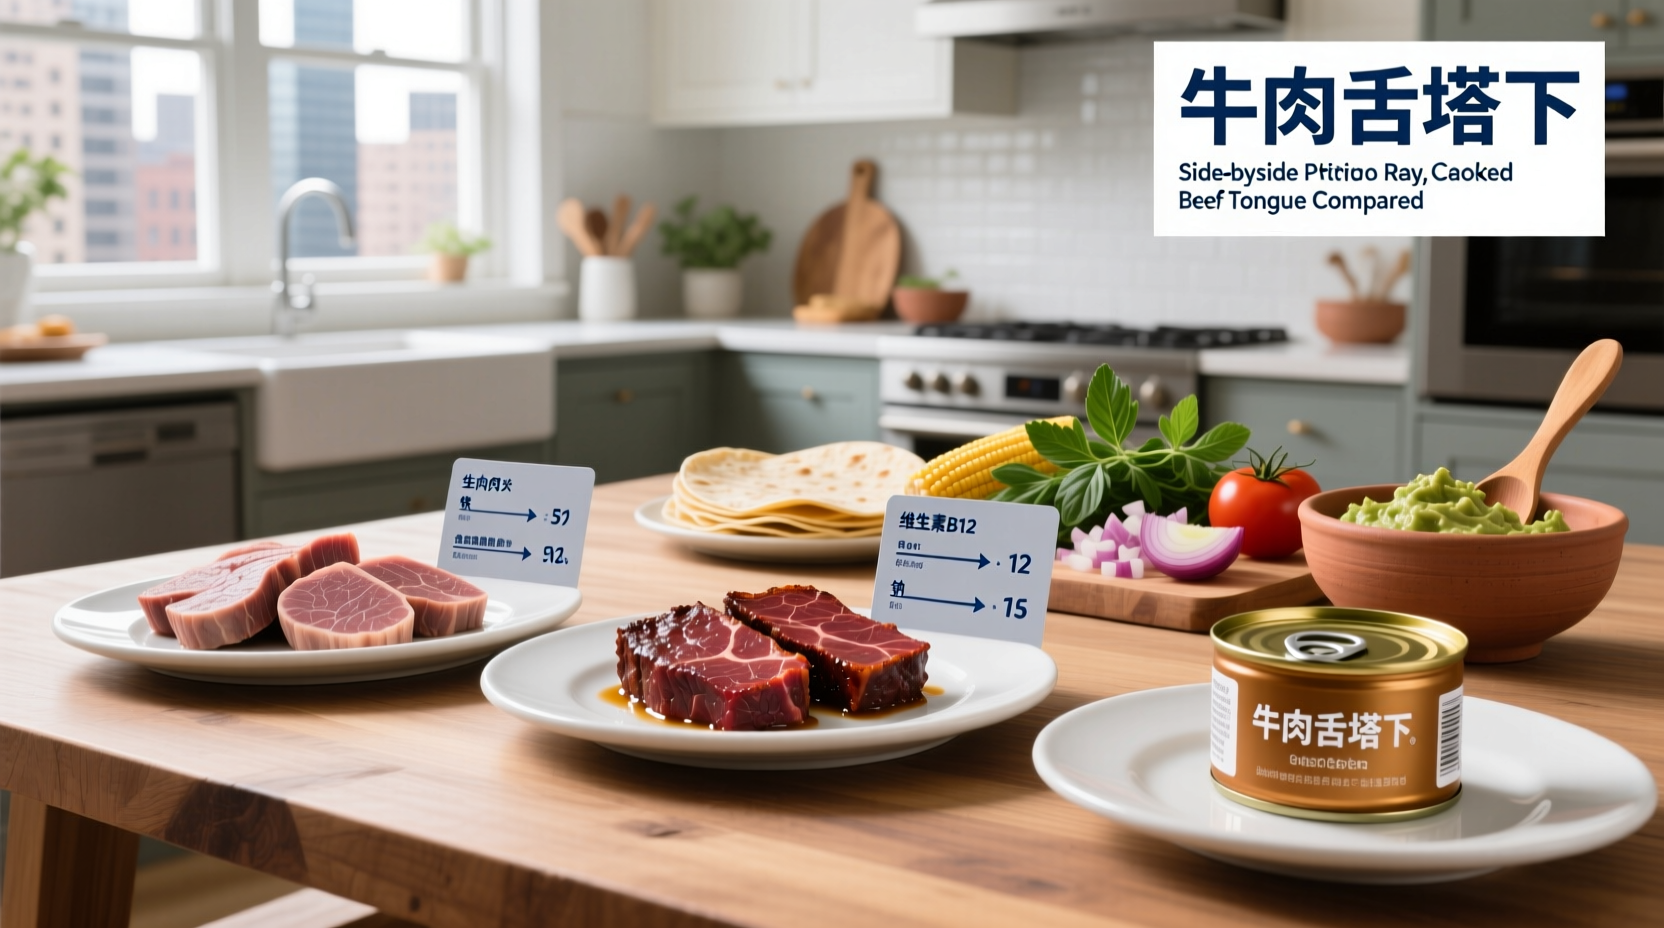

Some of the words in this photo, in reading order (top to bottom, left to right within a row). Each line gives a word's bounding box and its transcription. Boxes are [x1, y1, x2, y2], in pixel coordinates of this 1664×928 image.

[899, 511, 977, 534] 维生素B12
[1009, 553, 1032, 575] 12
[1003, 596, 1028, 620] 15
[1252, 703, 1412, 750] 牛肉舌塔下
